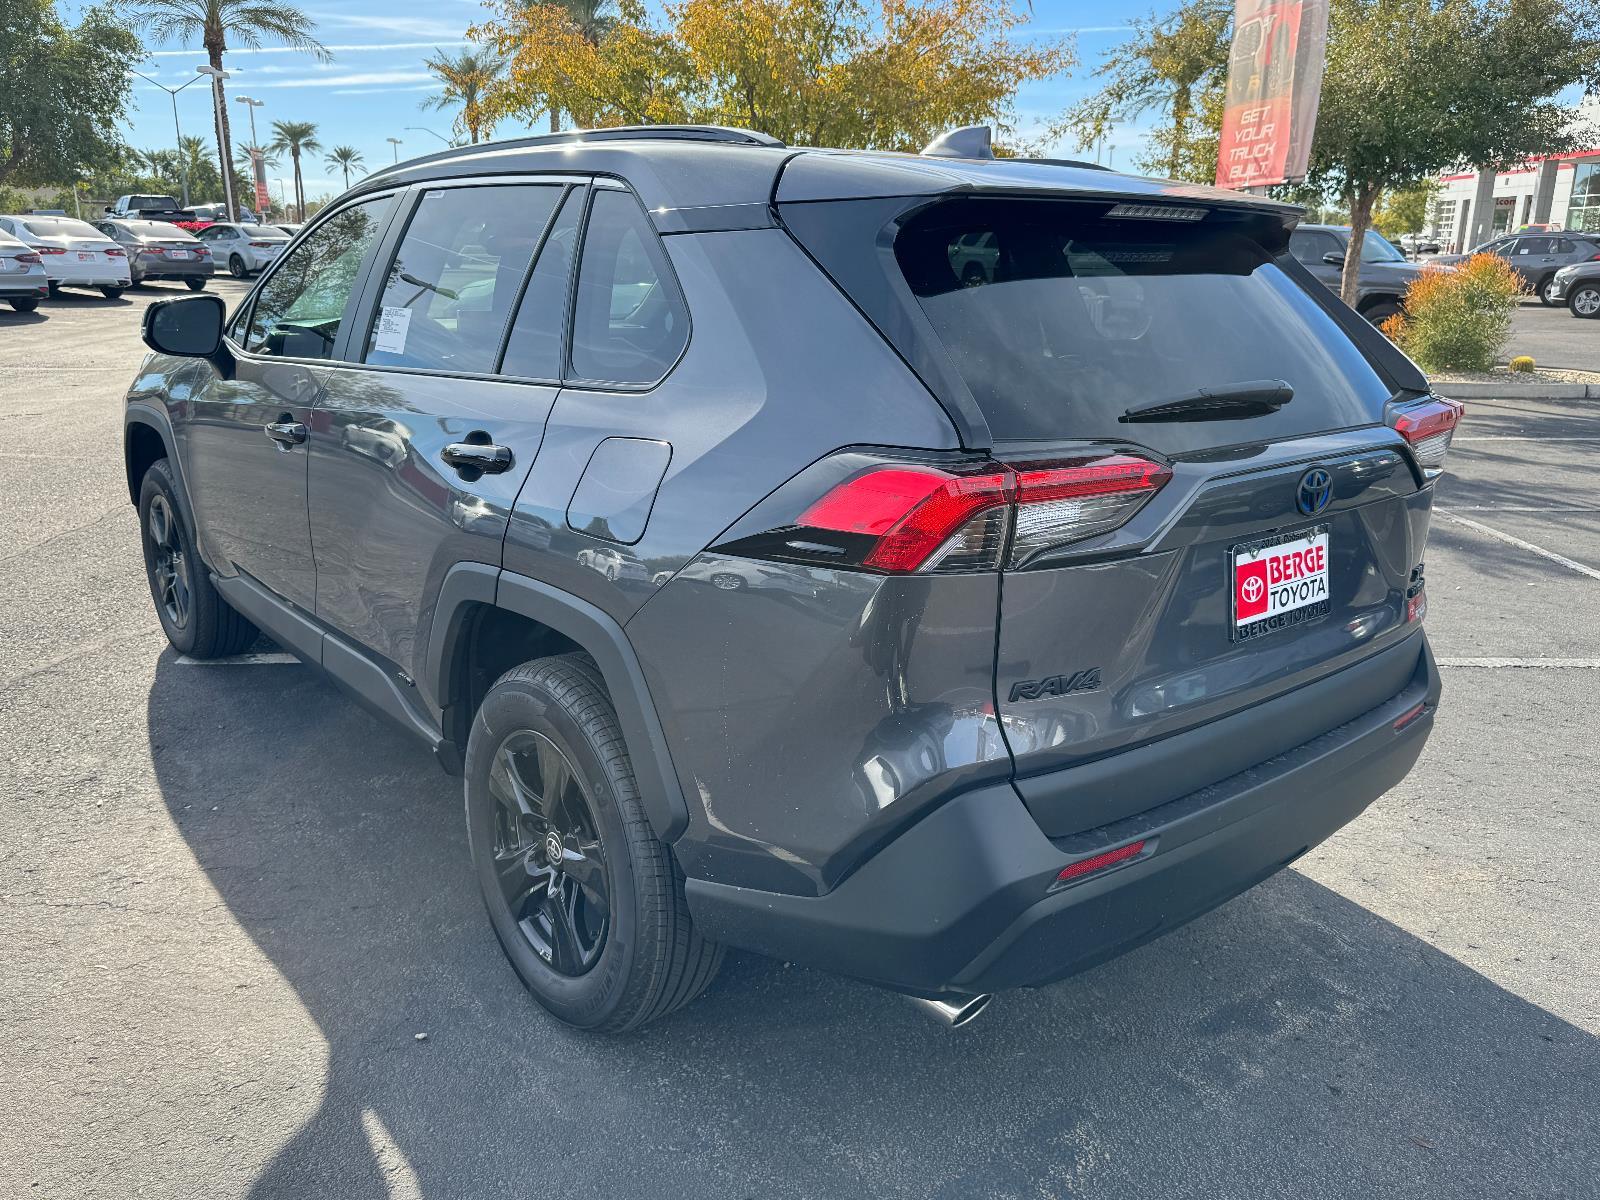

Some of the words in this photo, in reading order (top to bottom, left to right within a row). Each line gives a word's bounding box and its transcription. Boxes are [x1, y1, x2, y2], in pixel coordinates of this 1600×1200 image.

[1241, 105, 1271, 124] GET
[1235, 123, 1275, 143] YOUR
[1230, 142, 1277, 161] TRUCK
[1268, 545, 1325, 584] BERGE
[1270, 577, 1326, 609] TOYOTA
[1240, 614, 1286, 639] BERGE
[1289, 601, 1328, 623] TOYOTA
[1008, 667, 1103, 702] RAV4
